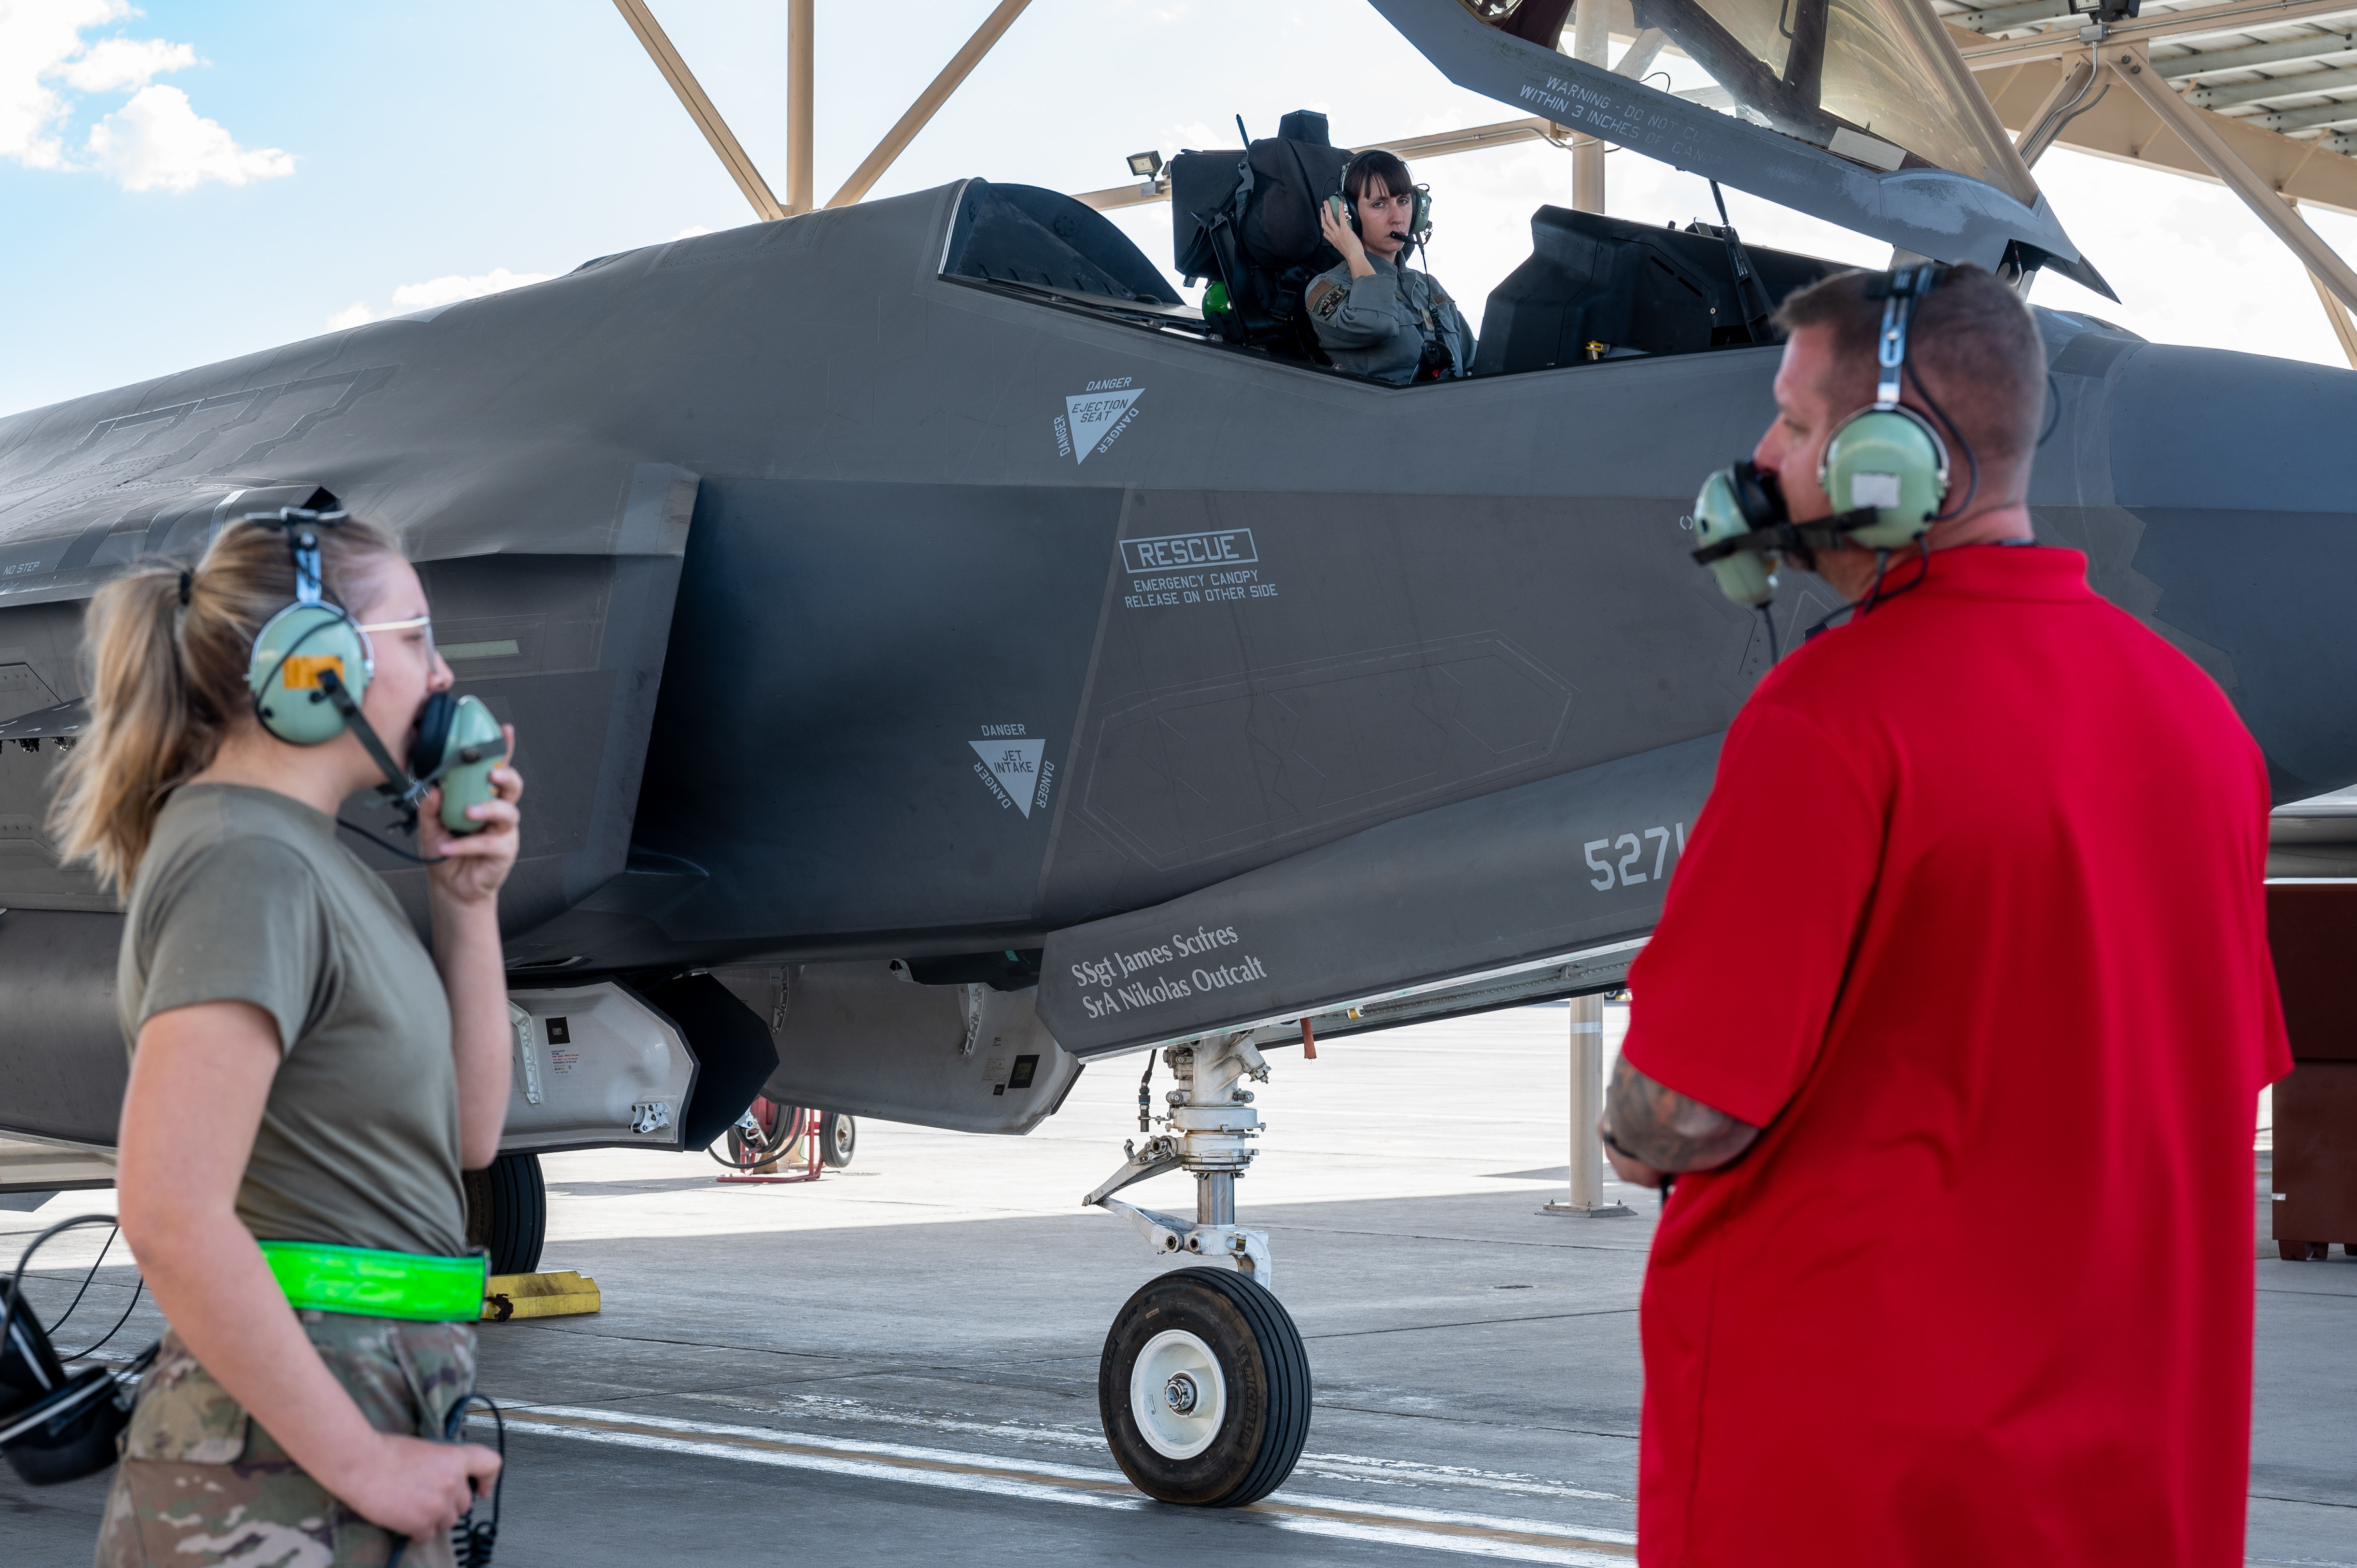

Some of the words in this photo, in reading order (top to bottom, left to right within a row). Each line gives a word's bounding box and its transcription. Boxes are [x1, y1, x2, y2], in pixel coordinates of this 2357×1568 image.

[1520, 84, 1569, 112] WITHIN
[1572, 105, 1584, 118] 3
[1587, 110, 1641, 139] INCHES
[1645, 131, 1665, 145] OF
[1546, 76, 1611, 109] WARNING
[1624, 104, 1644, 121] DO
[1648, 114, 1679, 133] NOT
[1086, 377, 1132, 392] DANGER
[1072, 399, 1129, 413] EJECTION
[1080, 410, 1113, 423] SEAT
[1054, 414, 1071, 457] DANGER
[1098, 407, 1139, 454] DANGER
[1137, 535, 1240, 567] RESCUE
[3, 565, 16, 575] NO
[17, 561, 40, 574] STEP
[1133, 575, 1204, 592] EMERGENCY
[1210, 570, 1257, 586] CANOPY
[1124, 592, 1179, 608] RELEASE
[1183, 591, 1200, 604] ON
[1204, 587, 1246, 602] OTHER
[1250, 584, 1278, 597] SIDE
[981, 724, 1026, 736] DANGER
[994, 761, 1034, 773] INTAKE
[1002, 750, 1022, 761] JET
[974, 761, 1012, 809] DANGER
[1036, 760, 1055, 809] DANGER
[1072, 956, 1116, 987] SSgt
[1114, 944, 1173, 979] James
[1172, 925, 1239, 957] Scifres
[1083, 992, 1121, 1019] SrA
[1117, 976, 1192, 1010] Nikolas
[1192, 955, 1267, 992] Outcalt
[1121, 1304, 1138, 1331] AIR
[1241, 1366, 1256, 1451] MICHELIN
